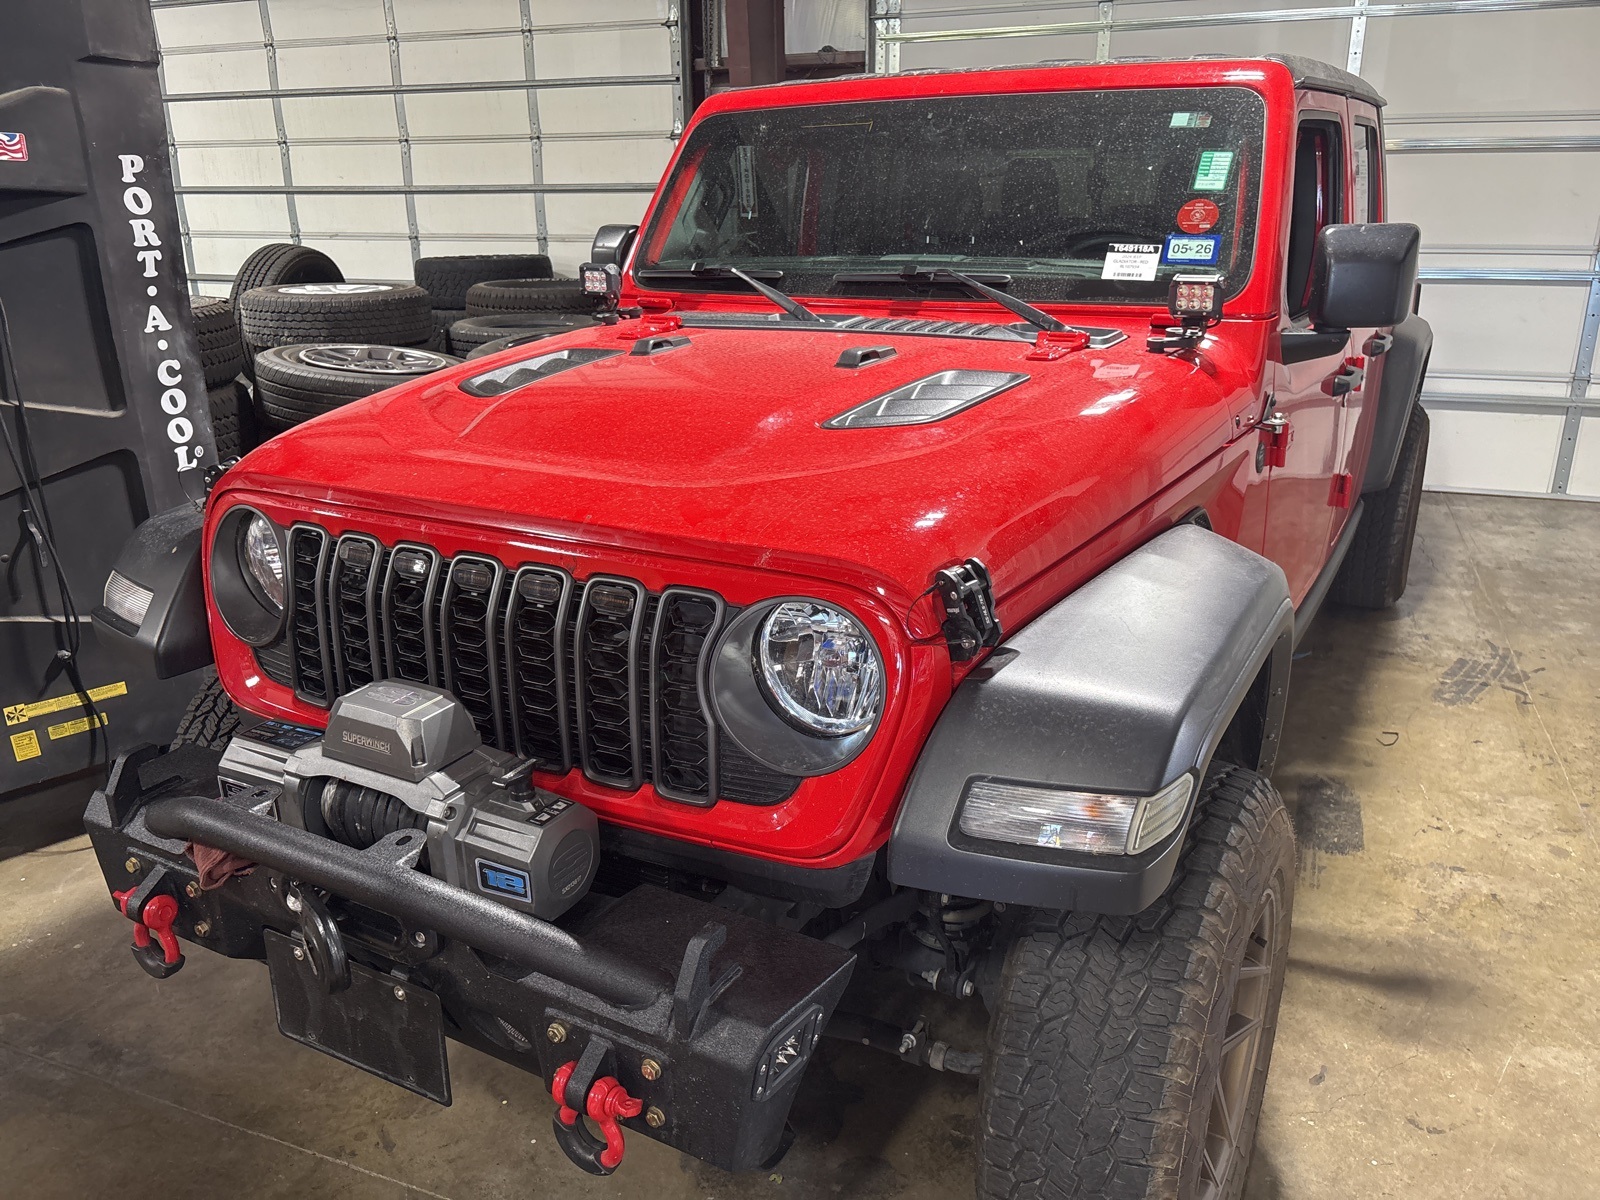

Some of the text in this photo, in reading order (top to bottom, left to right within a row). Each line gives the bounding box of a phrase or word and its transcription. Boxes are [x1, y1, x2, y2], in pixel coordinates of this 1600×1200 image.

[1113, 243, 1155, 253] T649118A
[1172, 243, 1212, 254] 05 26
[342, 731, 391, 752] SUPERWINCH
